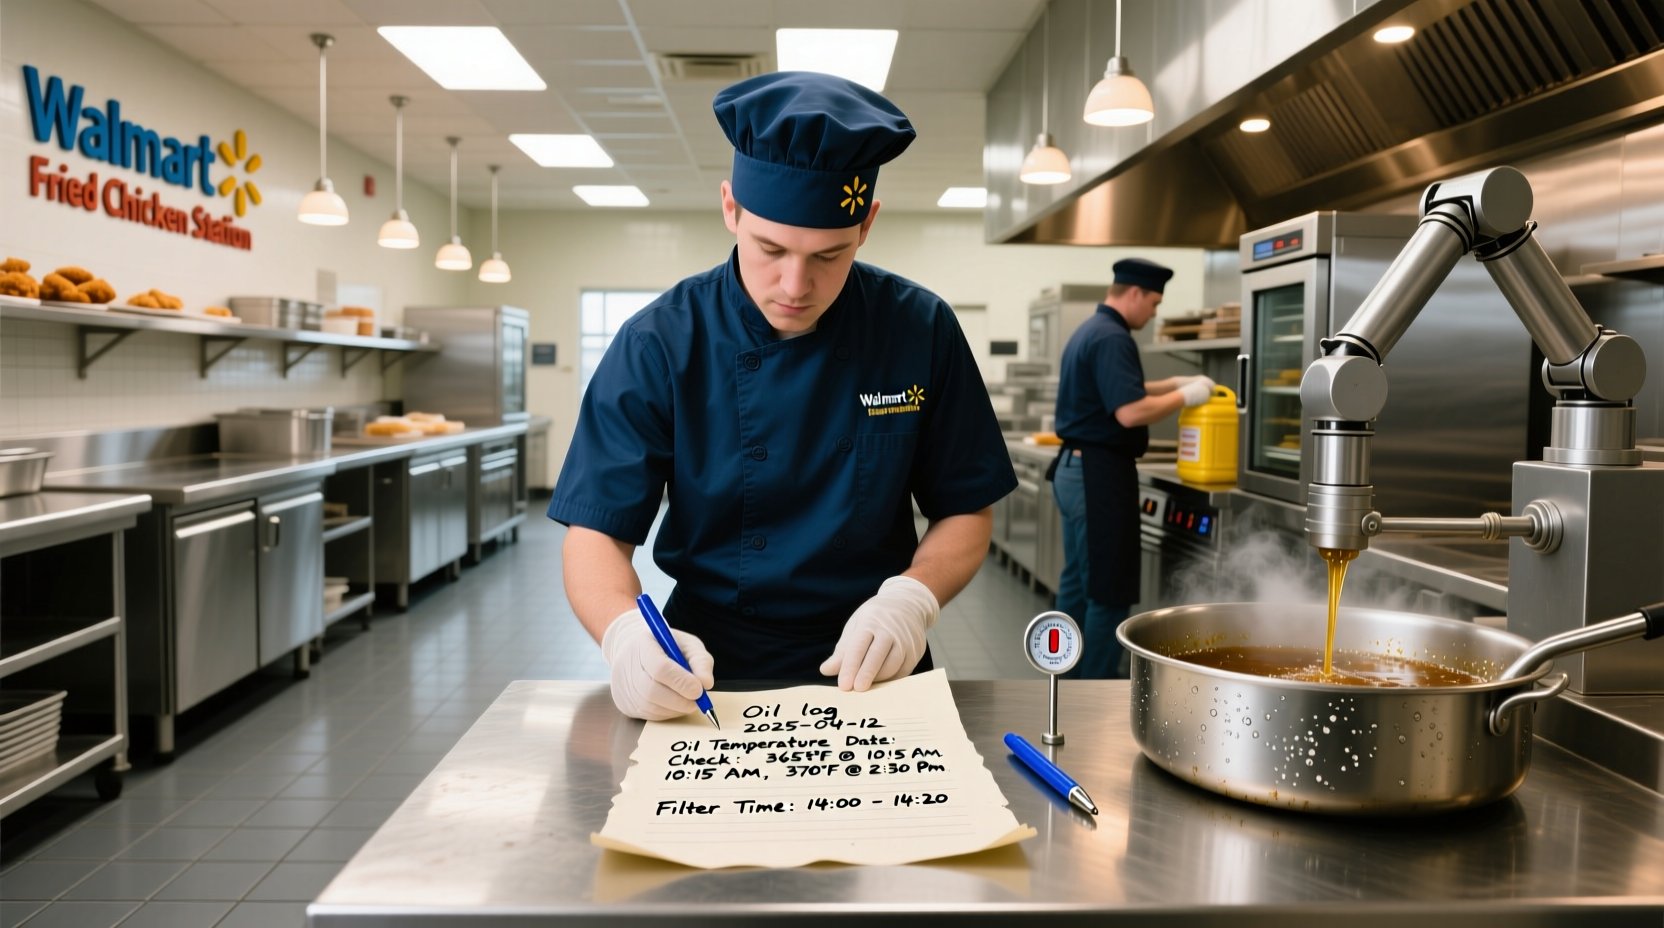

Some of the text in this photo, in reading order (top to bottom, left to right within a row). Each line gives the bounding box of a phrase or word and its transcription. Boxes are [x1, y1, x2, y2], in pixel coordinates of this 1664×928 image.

[22, 64, 216, 196] Walmart
[29, 155, 98, 211] Fried
[102, 178, 188, 235] Chicken
[742, 702, 838, 721] Oil log
[743, 718, 886, 733] 2025-04-12
[670, 740, 700, 752] Oil
[709, 736, 831, 755] Temperature
[664, 768, 717, 781] 10:15
[868, 763, 911, 775] 2:30
[655, 800, 721, 816] Filter
[733, 800, 795, 814] Time:
[807, 797, 862, 811] 14:00
[893, 793, 949, 808] 14:20
